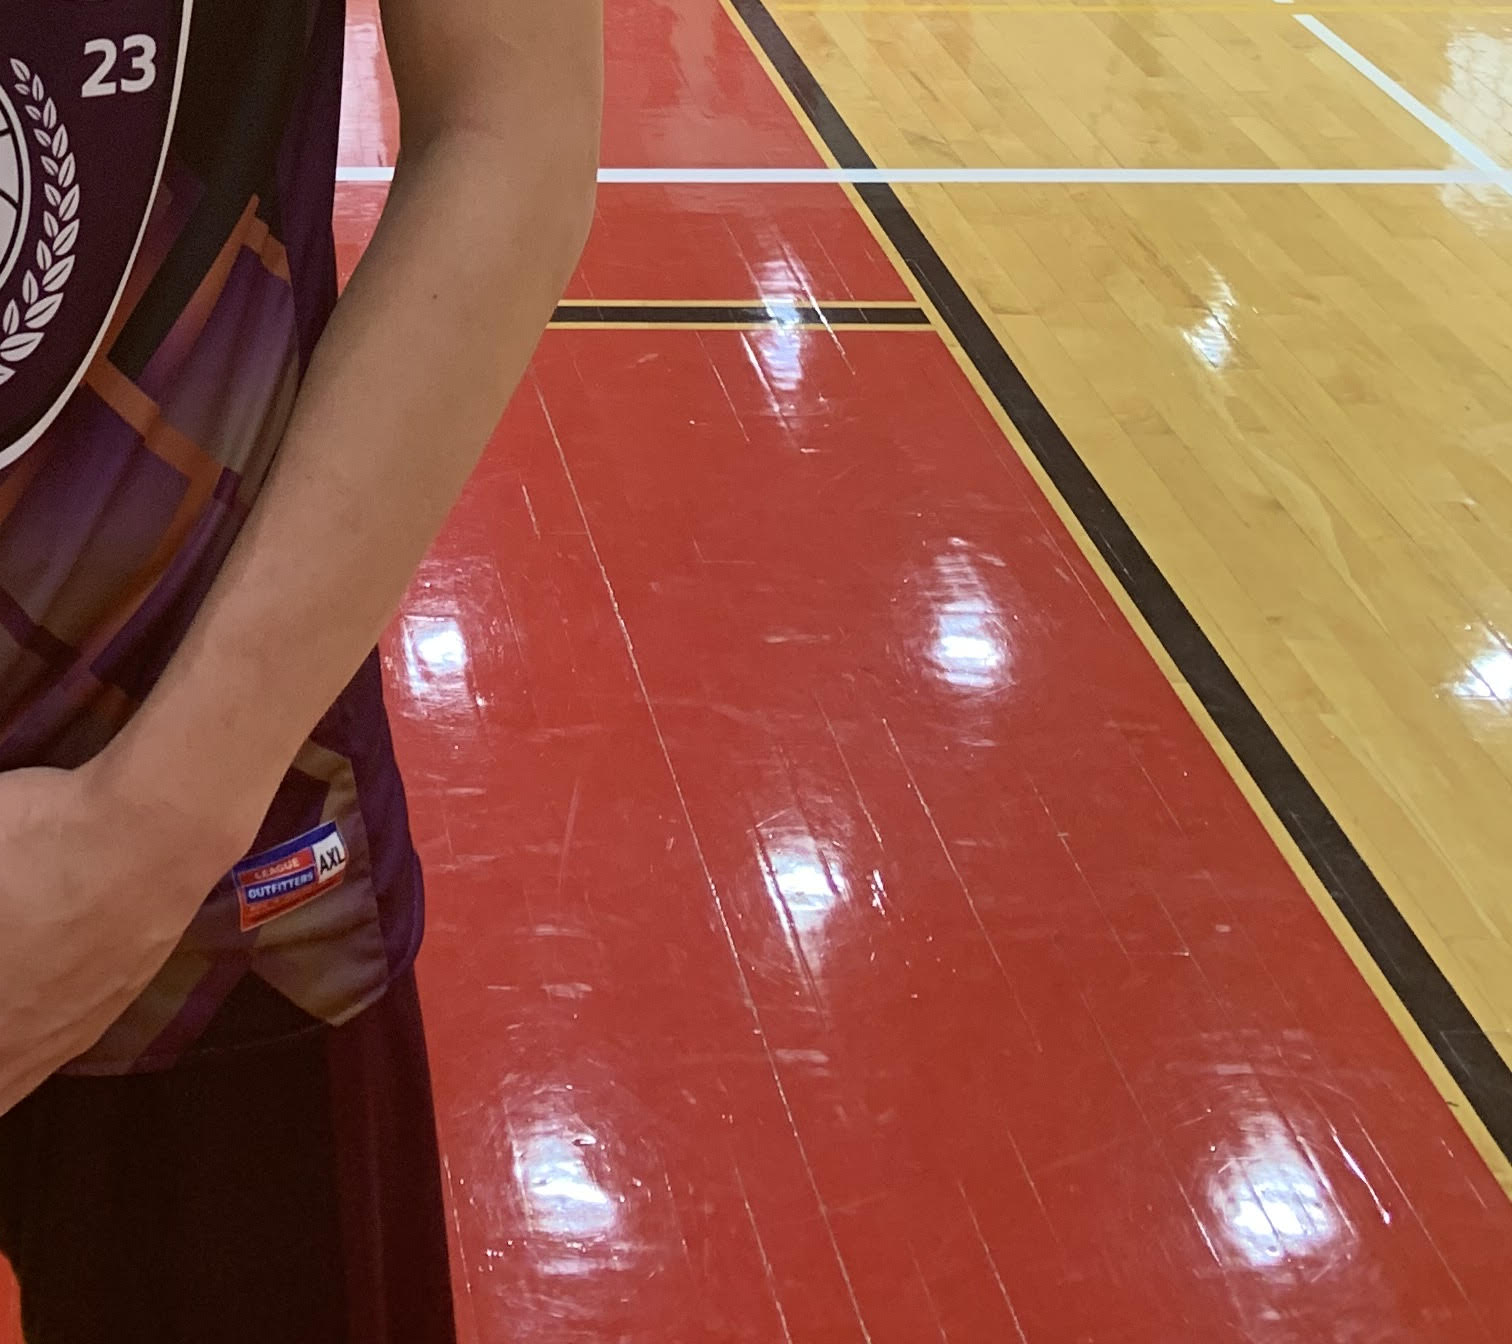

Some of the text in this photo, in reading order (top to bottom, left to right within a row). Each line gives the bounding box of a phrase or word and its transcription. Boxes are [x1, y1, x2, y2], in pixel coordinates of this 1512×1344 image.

[82, 33, 158, 98] 23
[254, 857, 300, 880] LEAGUE
[319, 846, 346, 874] AXL
[248, 870, 314, 900] OUTFITTERS
